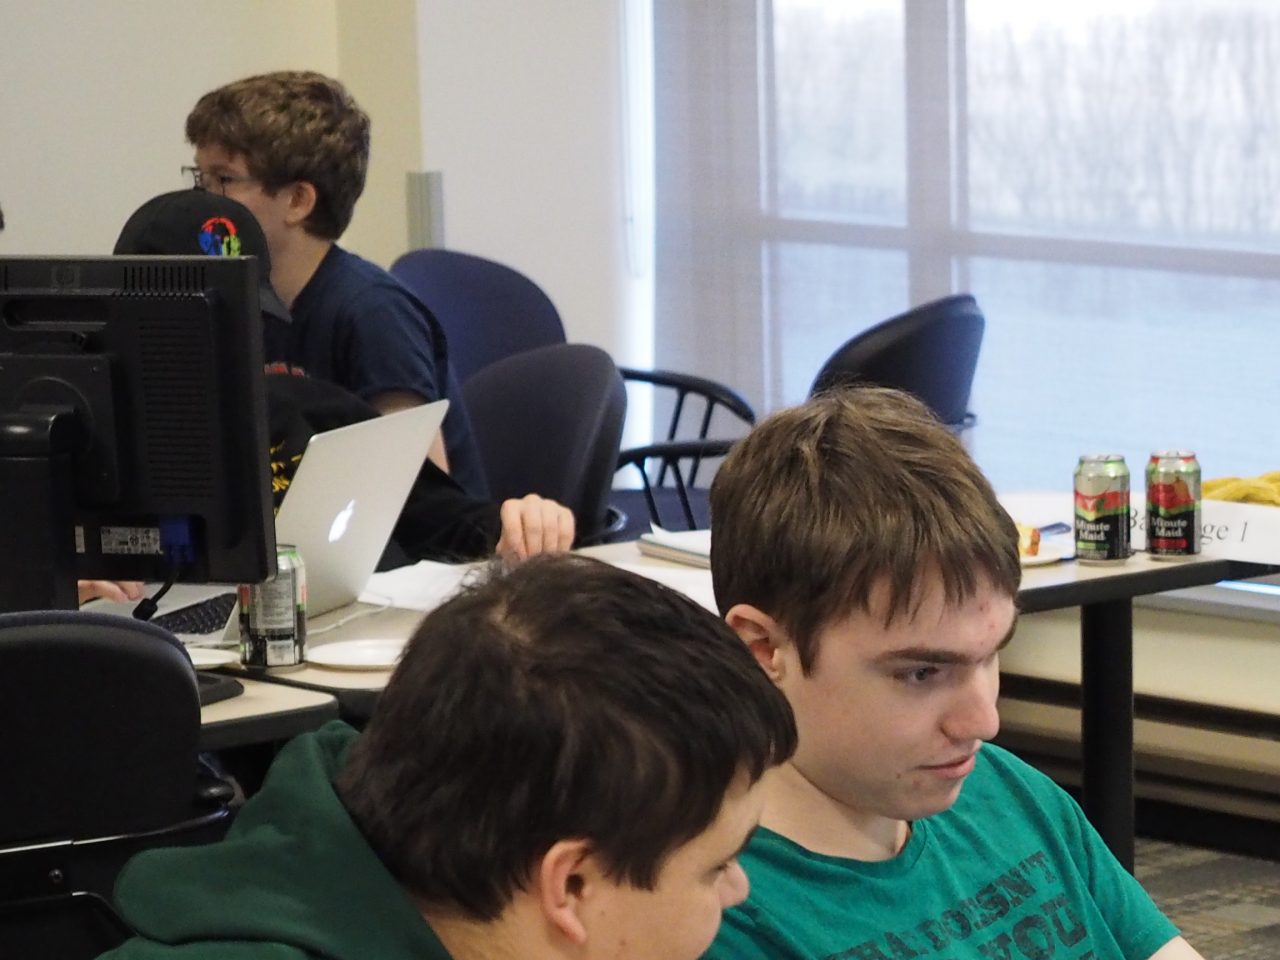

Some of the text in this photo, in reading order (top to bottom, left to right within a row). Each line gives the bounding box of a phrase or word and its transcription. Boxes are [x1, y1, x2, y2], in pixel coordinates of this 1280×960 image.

[1076, 518, 1110, 532] Minute
[1150, 517, 1188, 530] Minute
[1079, 530, 1105, 541] Maid
[1155, 526, 1182, 538] Maid
